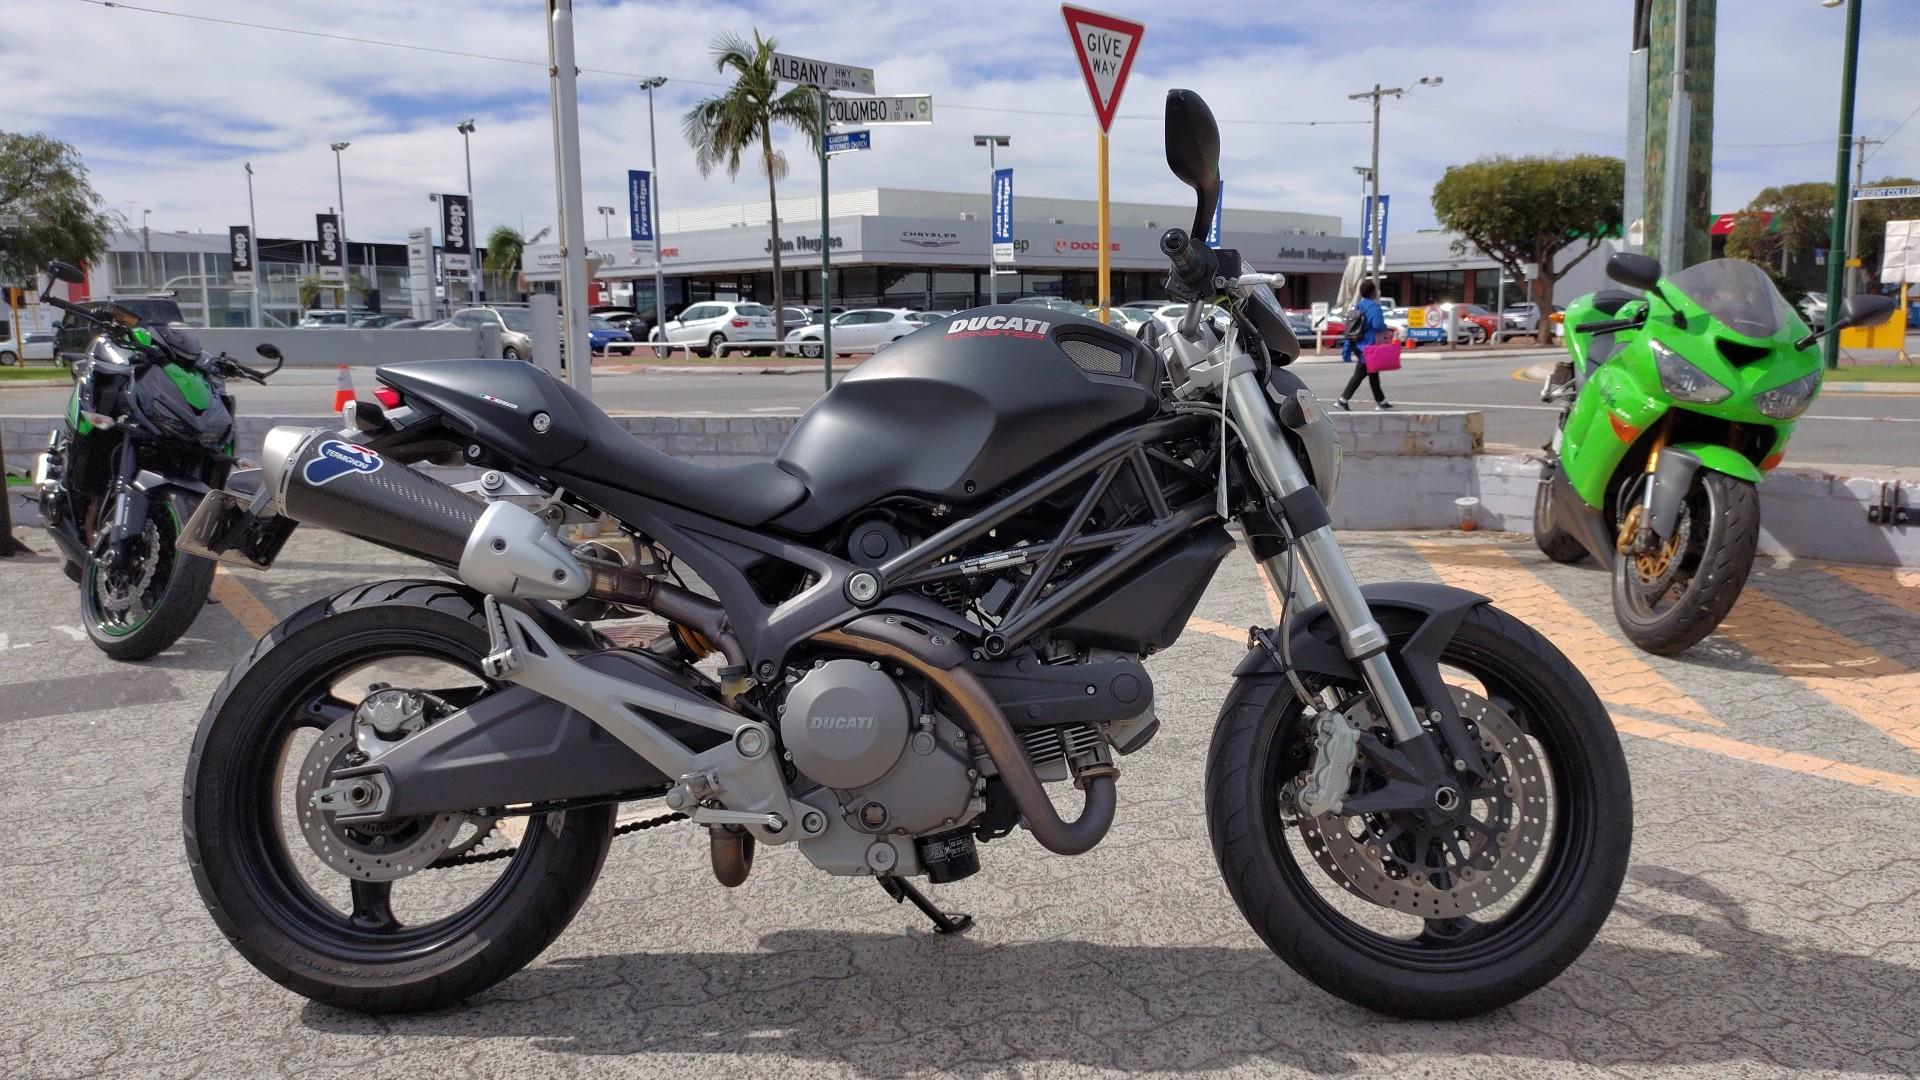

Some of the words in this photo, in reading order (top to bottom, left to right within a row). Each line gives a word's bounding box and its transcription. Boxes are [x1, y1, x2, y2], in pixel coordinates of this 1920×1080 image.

[1087, 33, 1122, 58] GIVE
[772, 57, 828, 84] ALBANY
[835, 68, 852, 79] HWY
[1092, 58, 1117, 77] WAY
[828, 101, 887, 121] COLOMBO
[895, 100, 903, 111] ST
[640, 179, 649, 236] Prestige
[447, 204, 466, 248] Jeep
[234, 232, 248, 267] Jeep
[321, 222, 337, 261] Jeep
[764, 237, 794, 253] Jhn
[796, 235, 843, 252] Huges
[1071, 242, 1121, 251] DODE
[1278, 247, 1305, 260] John
[1307, 248, 1346, 262] Hughes
[947, 315, 1051, 335] DUCATI
[1428, 329, 1439, 337] YOU
[326, 448, 369, 469] TERMIGNONI
[810, 716, 874, 730] DUCATI
